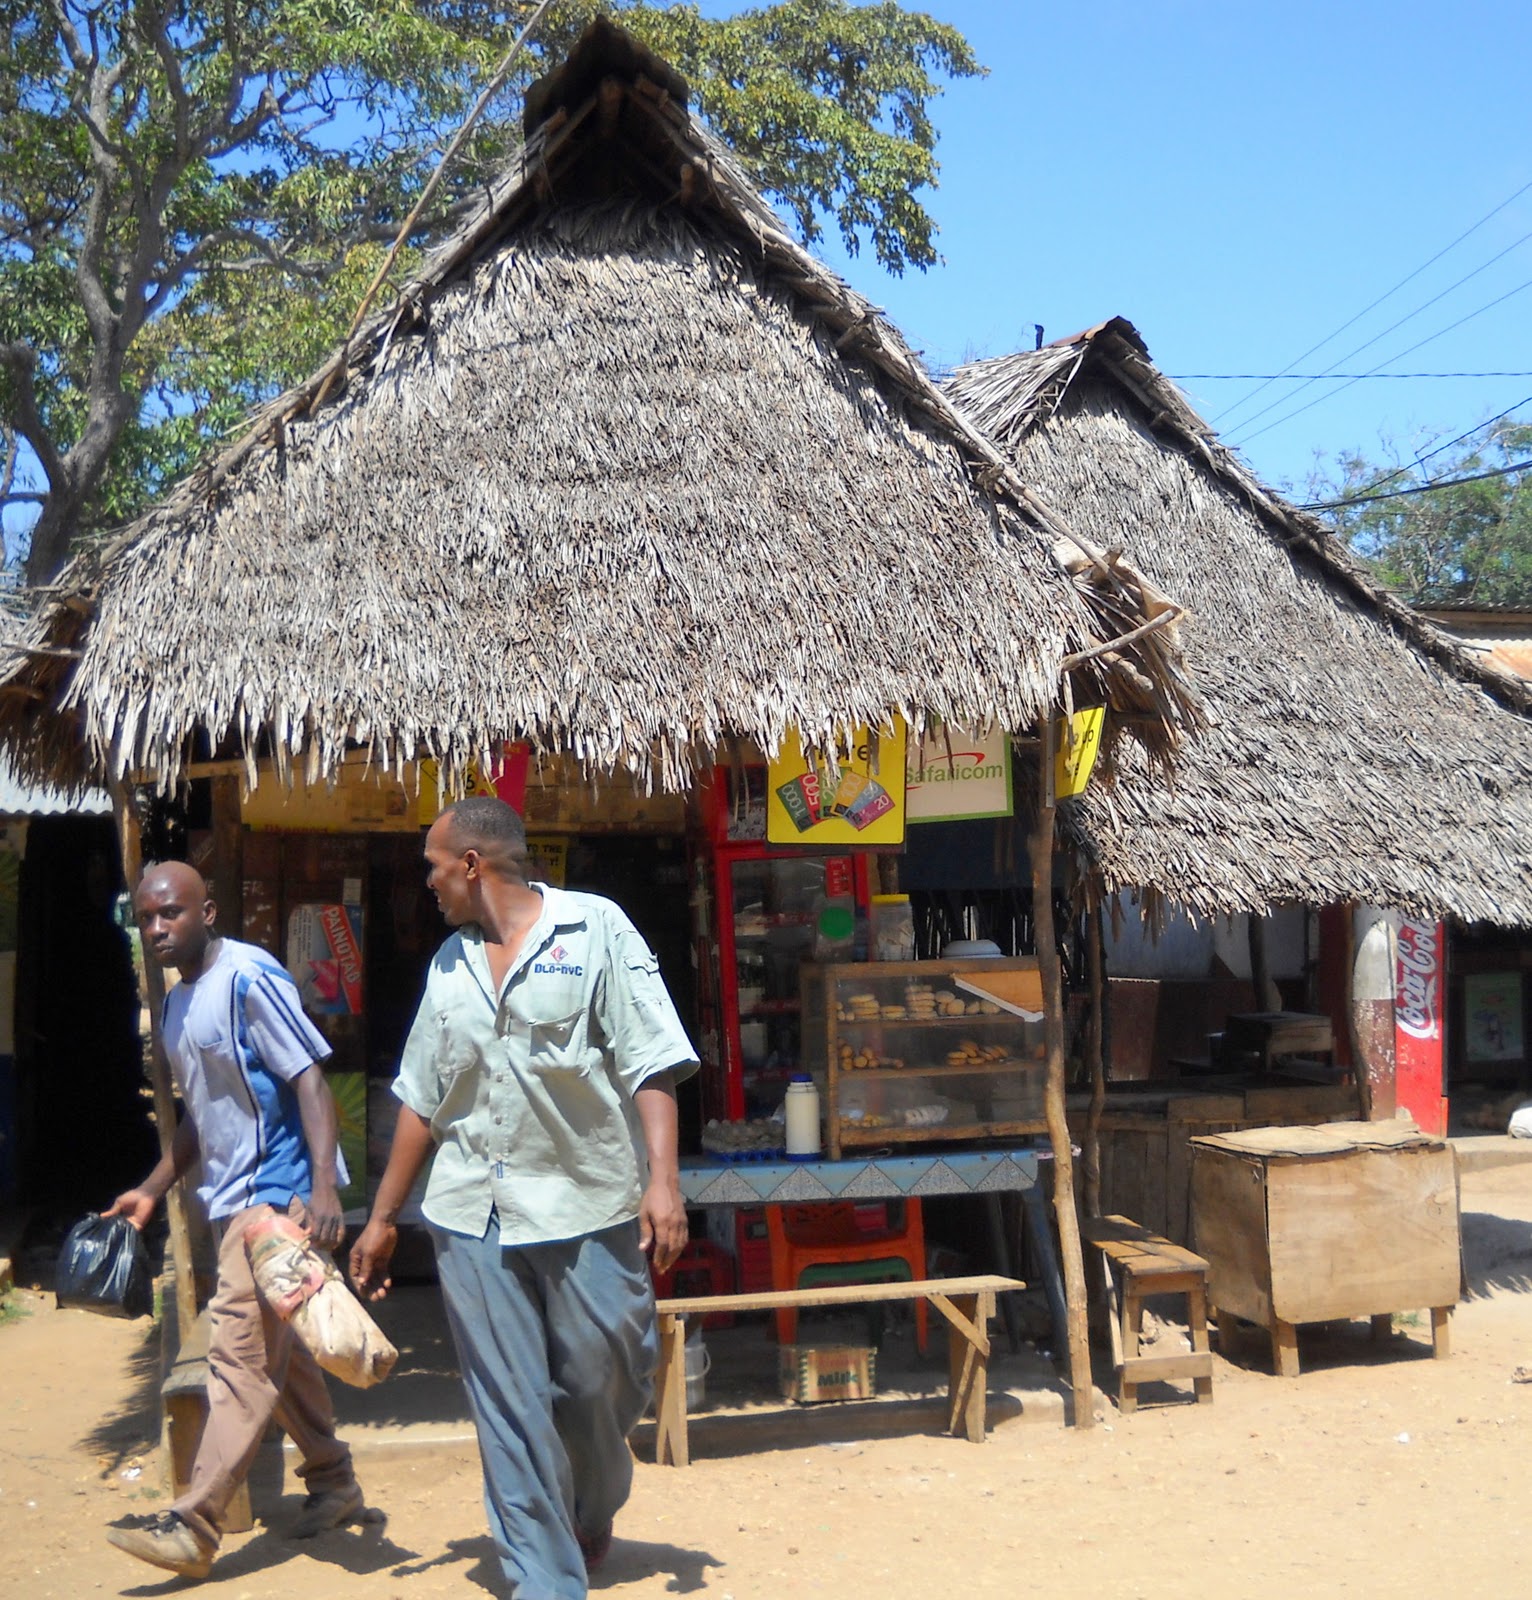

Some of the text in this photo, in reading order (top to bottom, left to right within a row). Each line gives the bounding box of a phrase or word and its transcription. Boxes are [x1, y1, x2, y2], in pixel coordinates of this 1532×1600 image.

[781, 784, 806, 818] 1000
[802, 774, 821, 806] 500
[873, 794, 890, 811] 20
[1395, 912, 1437, 1040] Coca-Col
[817, 1371, 857, 1387] Milk
